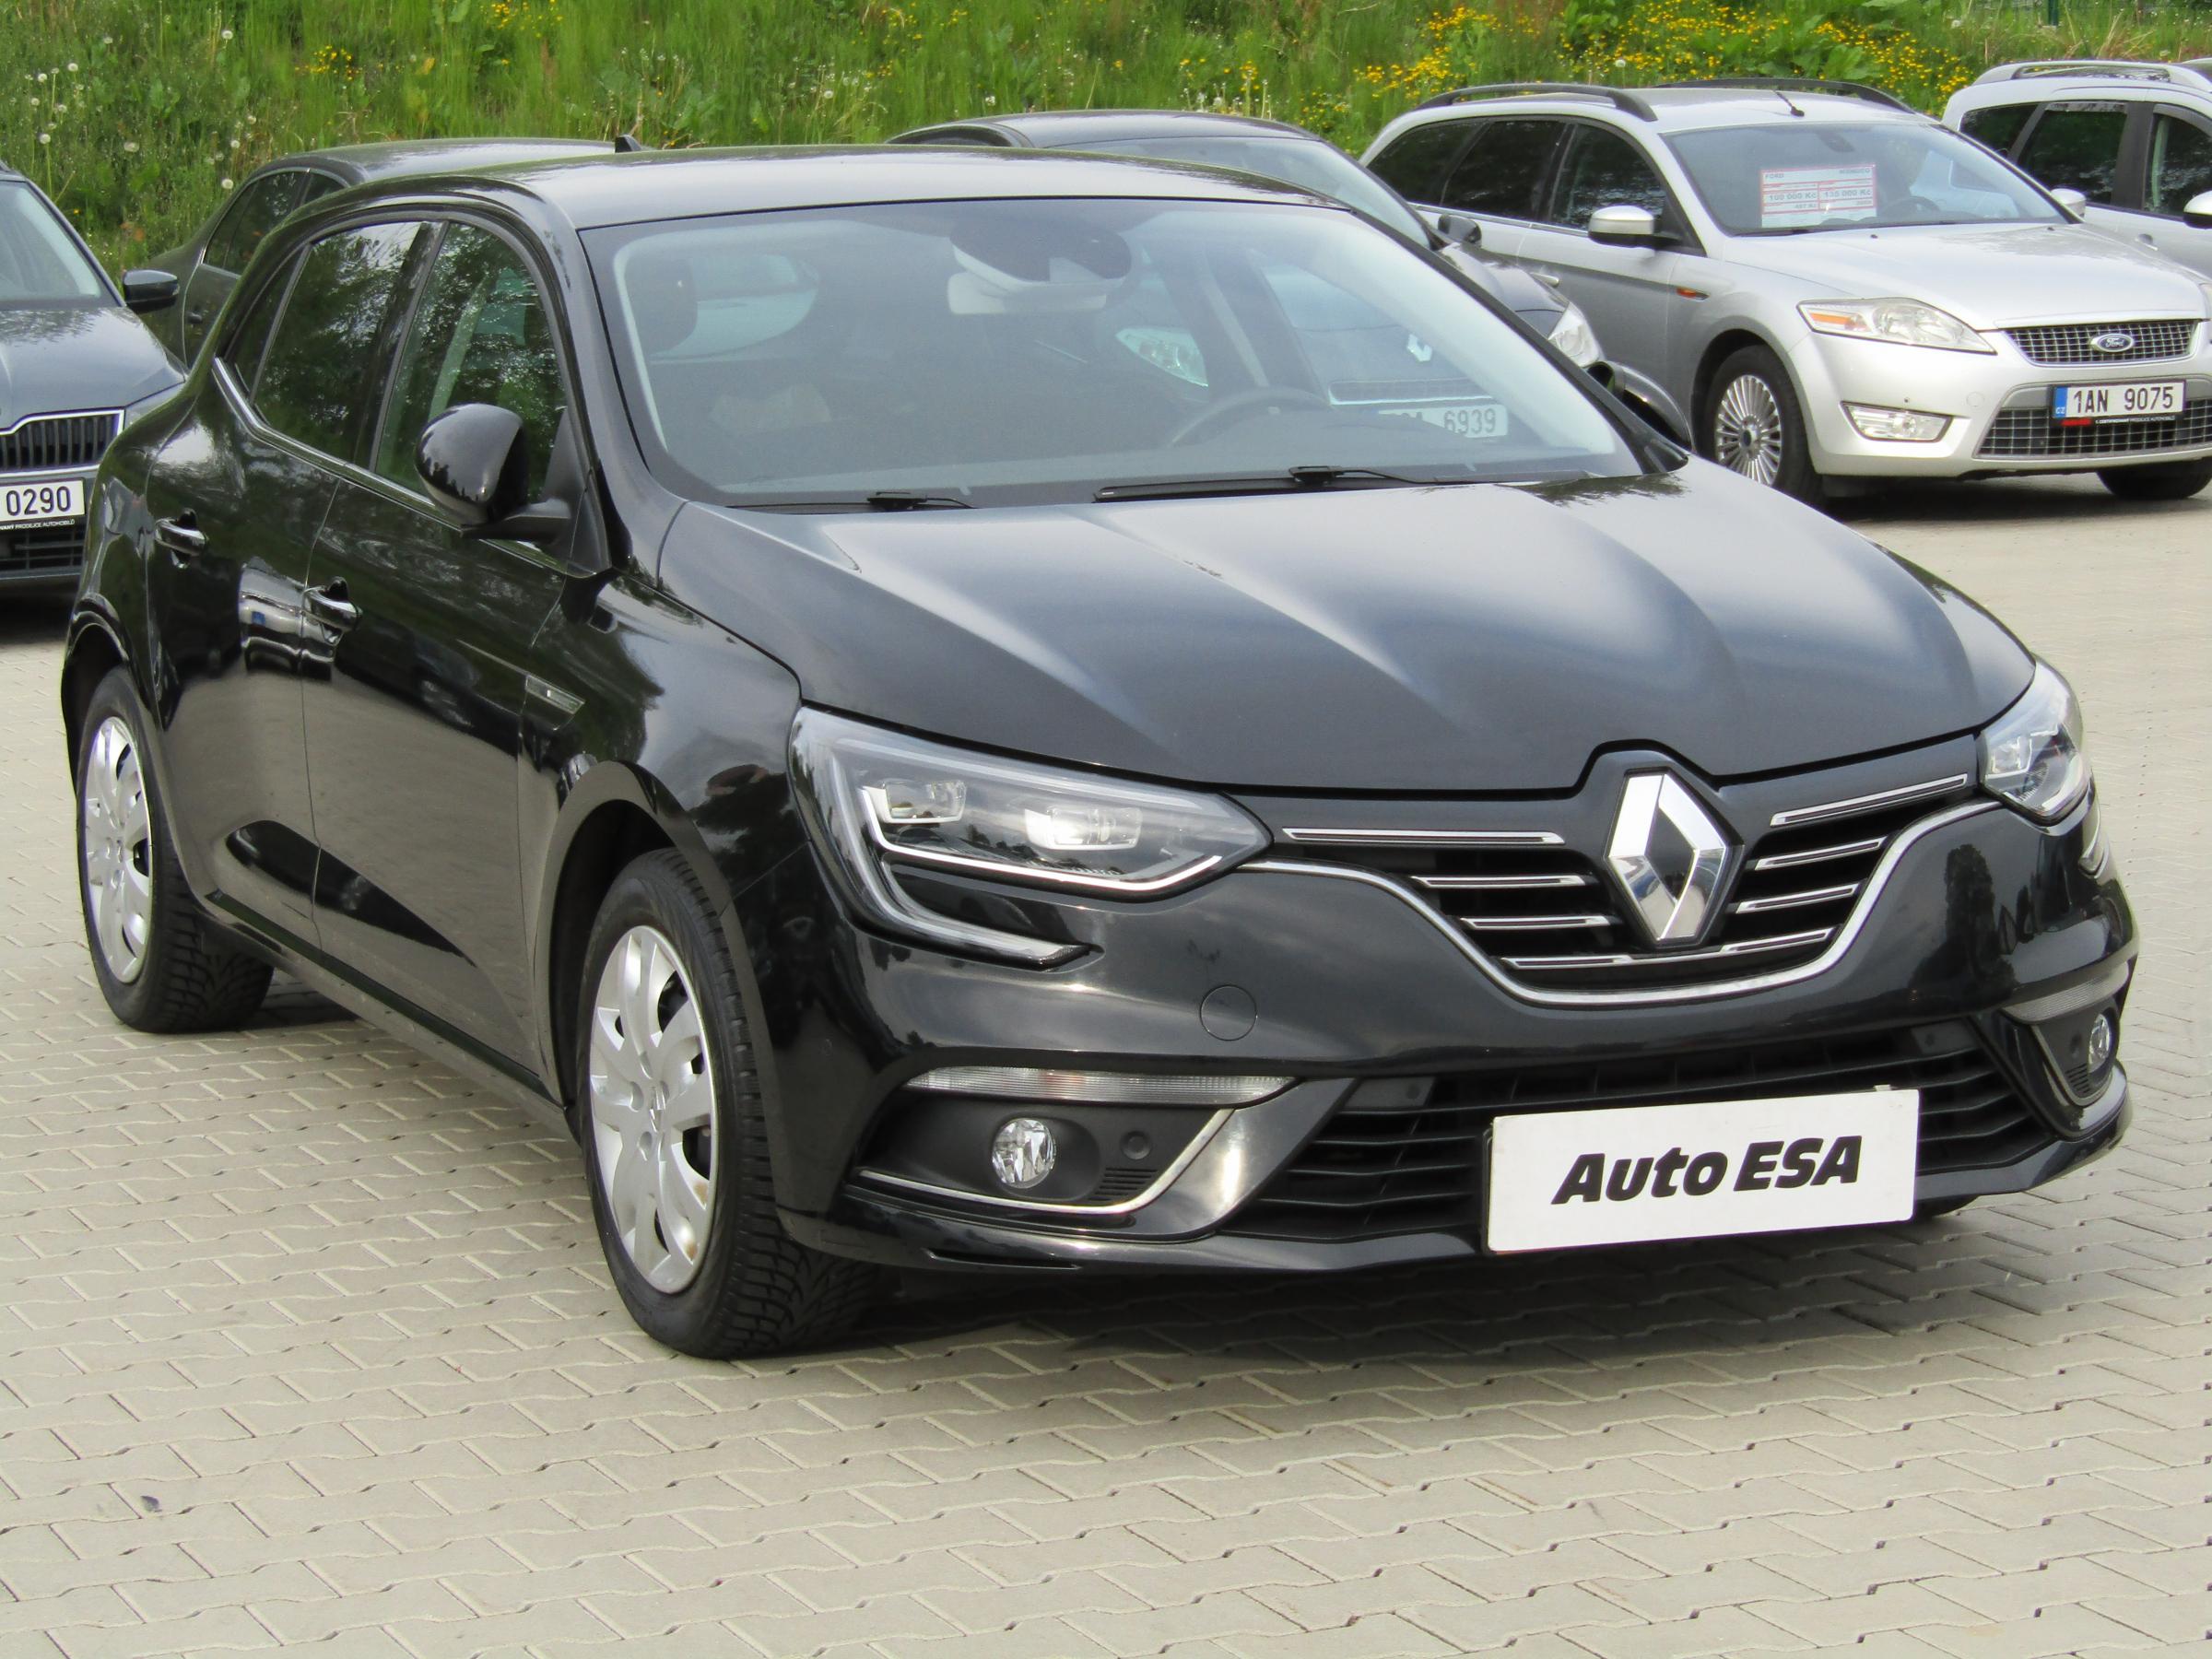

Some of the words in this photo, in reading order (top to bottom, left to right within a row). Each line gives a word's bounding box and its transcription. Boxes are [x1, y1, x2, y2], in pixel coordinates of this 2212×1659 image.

[2105, 337, 2124, 347] Ford
[2055, 406, 2065, 415] CZ
[2074, 389, 2109, 414] 1AN
[2124, 386, 2174, 411] 9075
[1443, 408, 1496, 434] 6939
[6, 486, 71, 516] 0290
[1551, 1147, 1728, 1205] Auto
[1734, 1135, 1862, 1192] ESA
